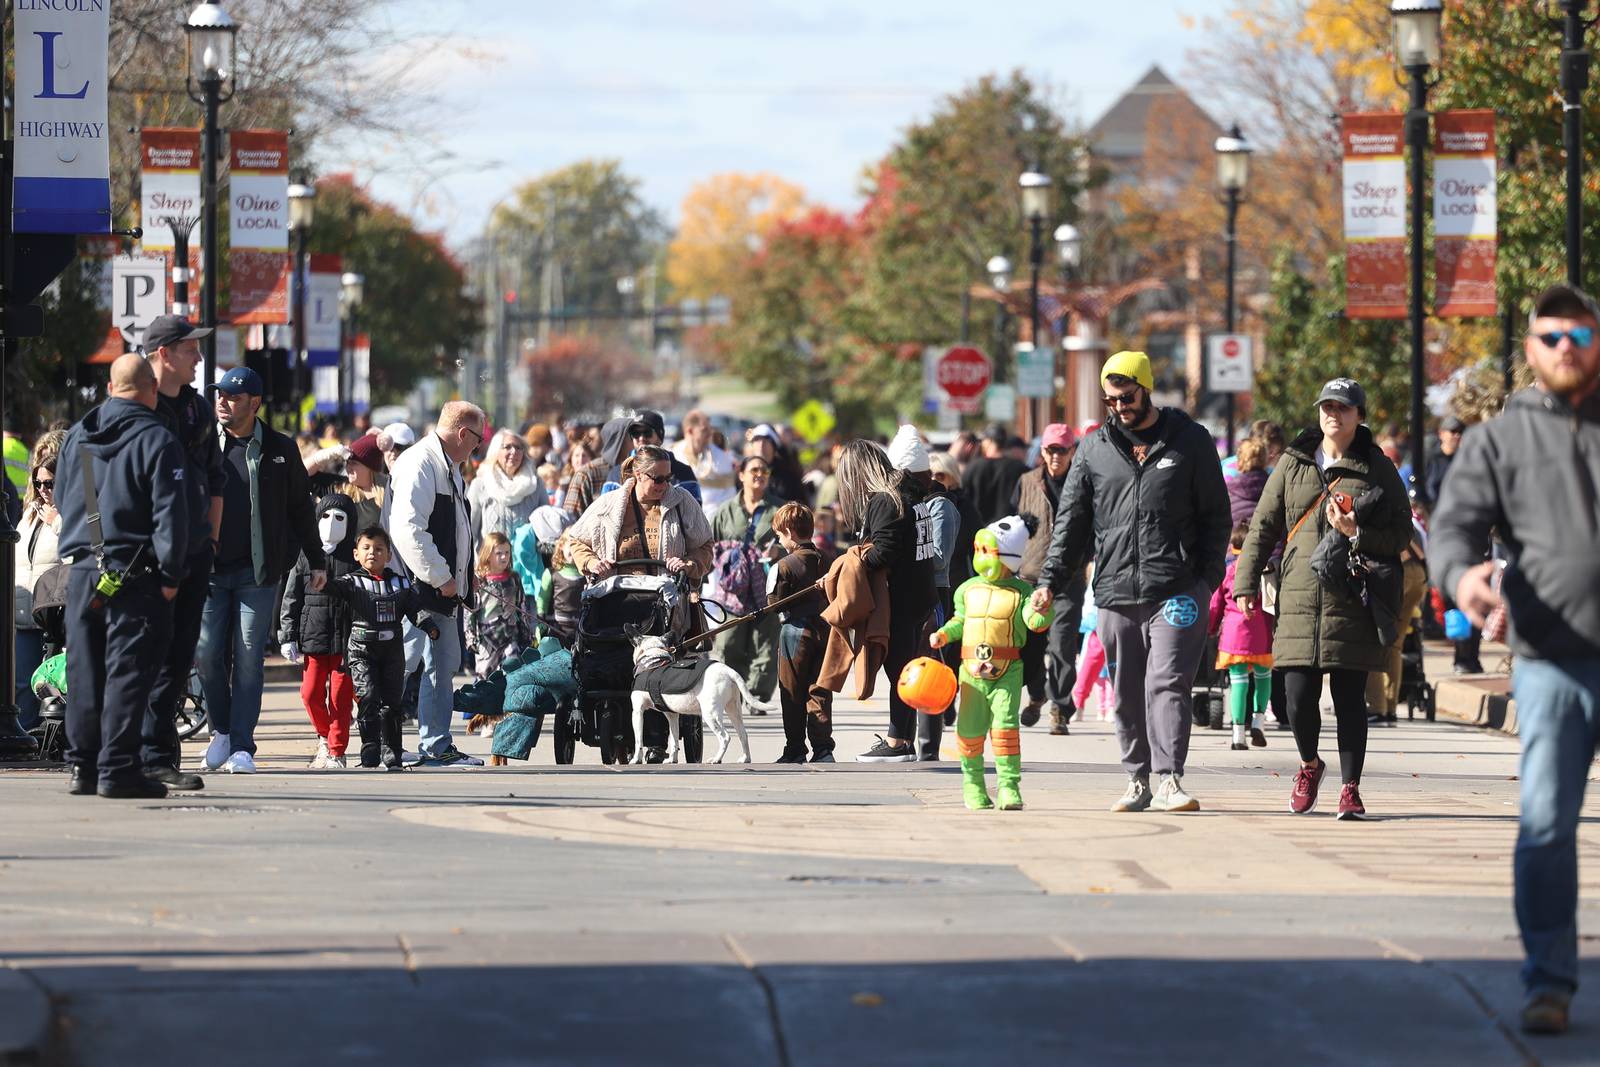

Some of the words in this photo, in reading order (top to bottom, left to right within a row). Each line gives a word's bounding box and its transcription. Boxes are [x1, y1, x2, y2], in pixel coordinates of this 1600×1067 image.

[19, 0, 104, 12] LINCOLN
[33, 31, 90, 99] L
[19, 121, 104, 138] HIGHWAY
[1352, 180, 1398, 204] Shop
[149, 192, 193, 217] Shop
[235, 193, 282, 212] Dine
[1351, 205, 1398, 218] LOCAL
[1440, 203, 1488, 216] LOCAL
[237, 217, 282, 230] LOCAL
[120, 274, 156, 318] P
[939, 361, 990, 384] STOP
